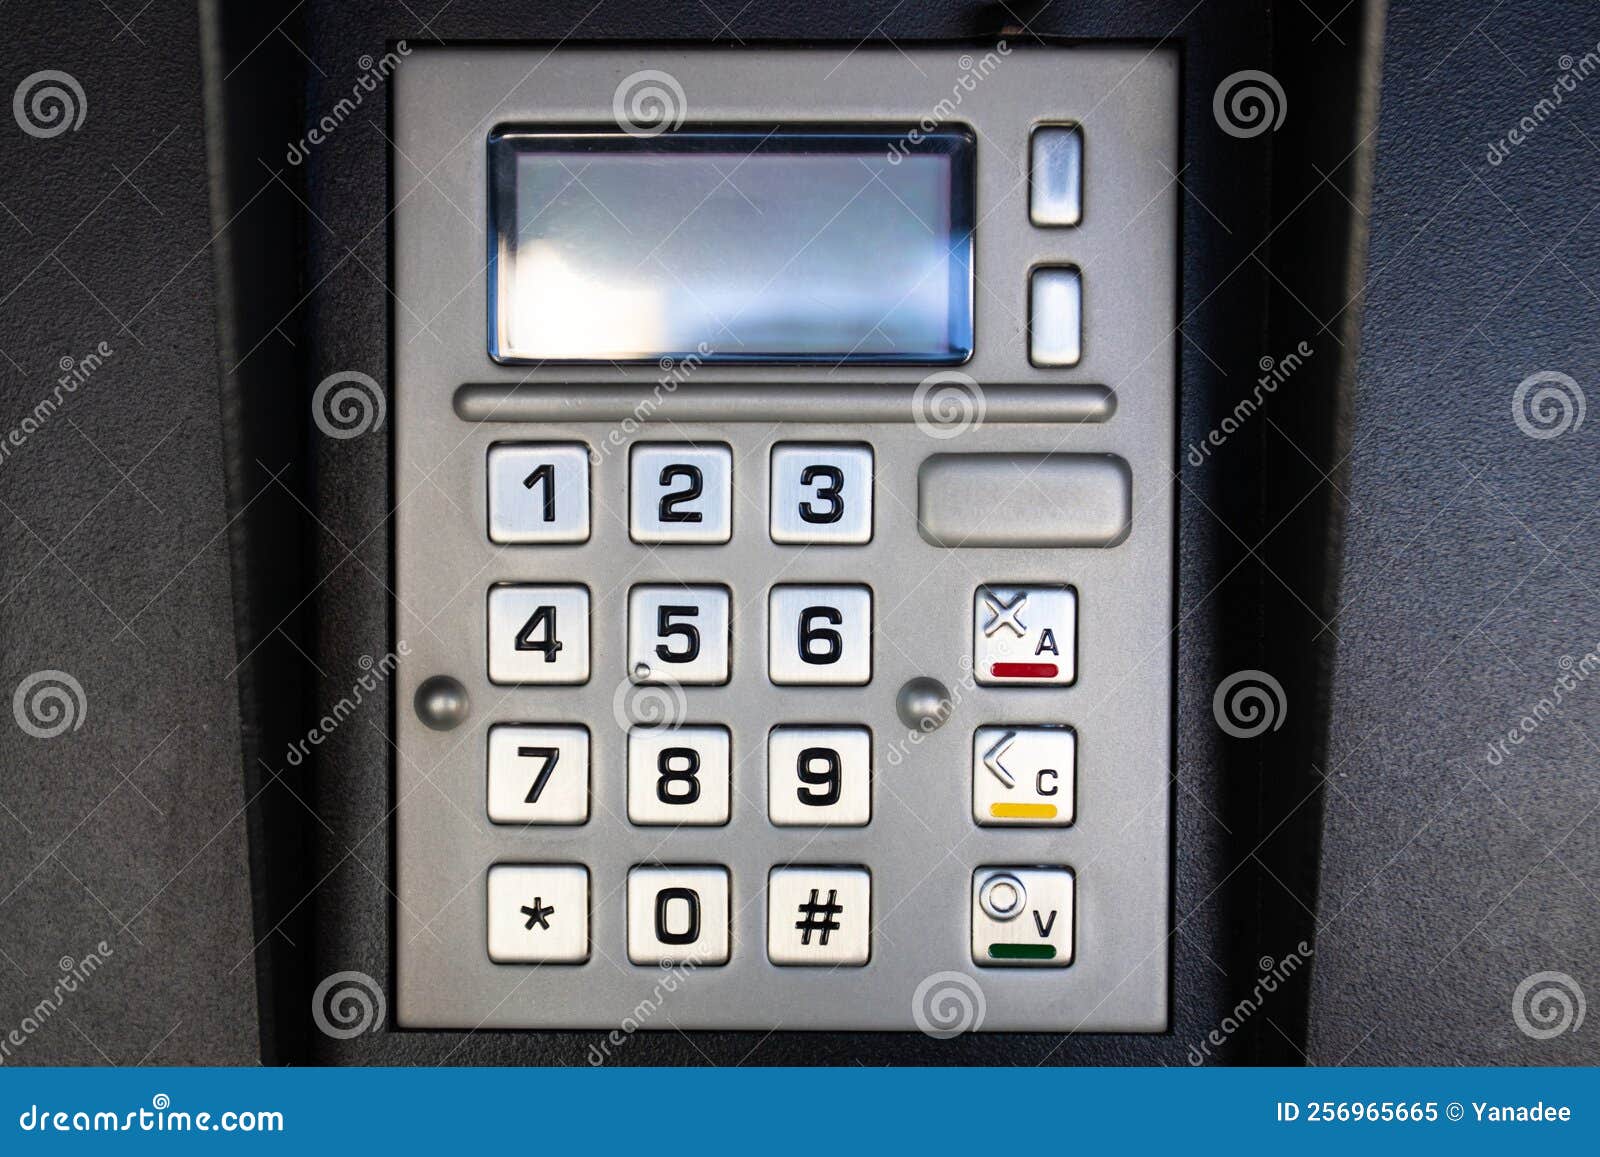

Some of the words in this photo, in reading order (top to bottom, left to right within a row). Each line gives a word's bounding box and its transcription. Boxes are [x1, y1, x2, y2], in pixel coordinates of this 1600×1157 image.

[523, 464, 556, 522] 1
[658, 463, 704, 523] 2
[798, 464, 845, 524] 3
[514, 605, 563, 663] 4
[655, 605, 701, 664] 5
[797, 605, 843, 665] 6
[1034, 628, 1060, 657] A
[517, 746, 560, 804] 7
[657, 747, 701, 805] 8
[796, 747, 842, 807] 9
[1035, 769, 1059, 797] C
[655, 887, 701, 946] 0
[795, 888, 843, 946] #
[1032, 910, 1058, 938] V
